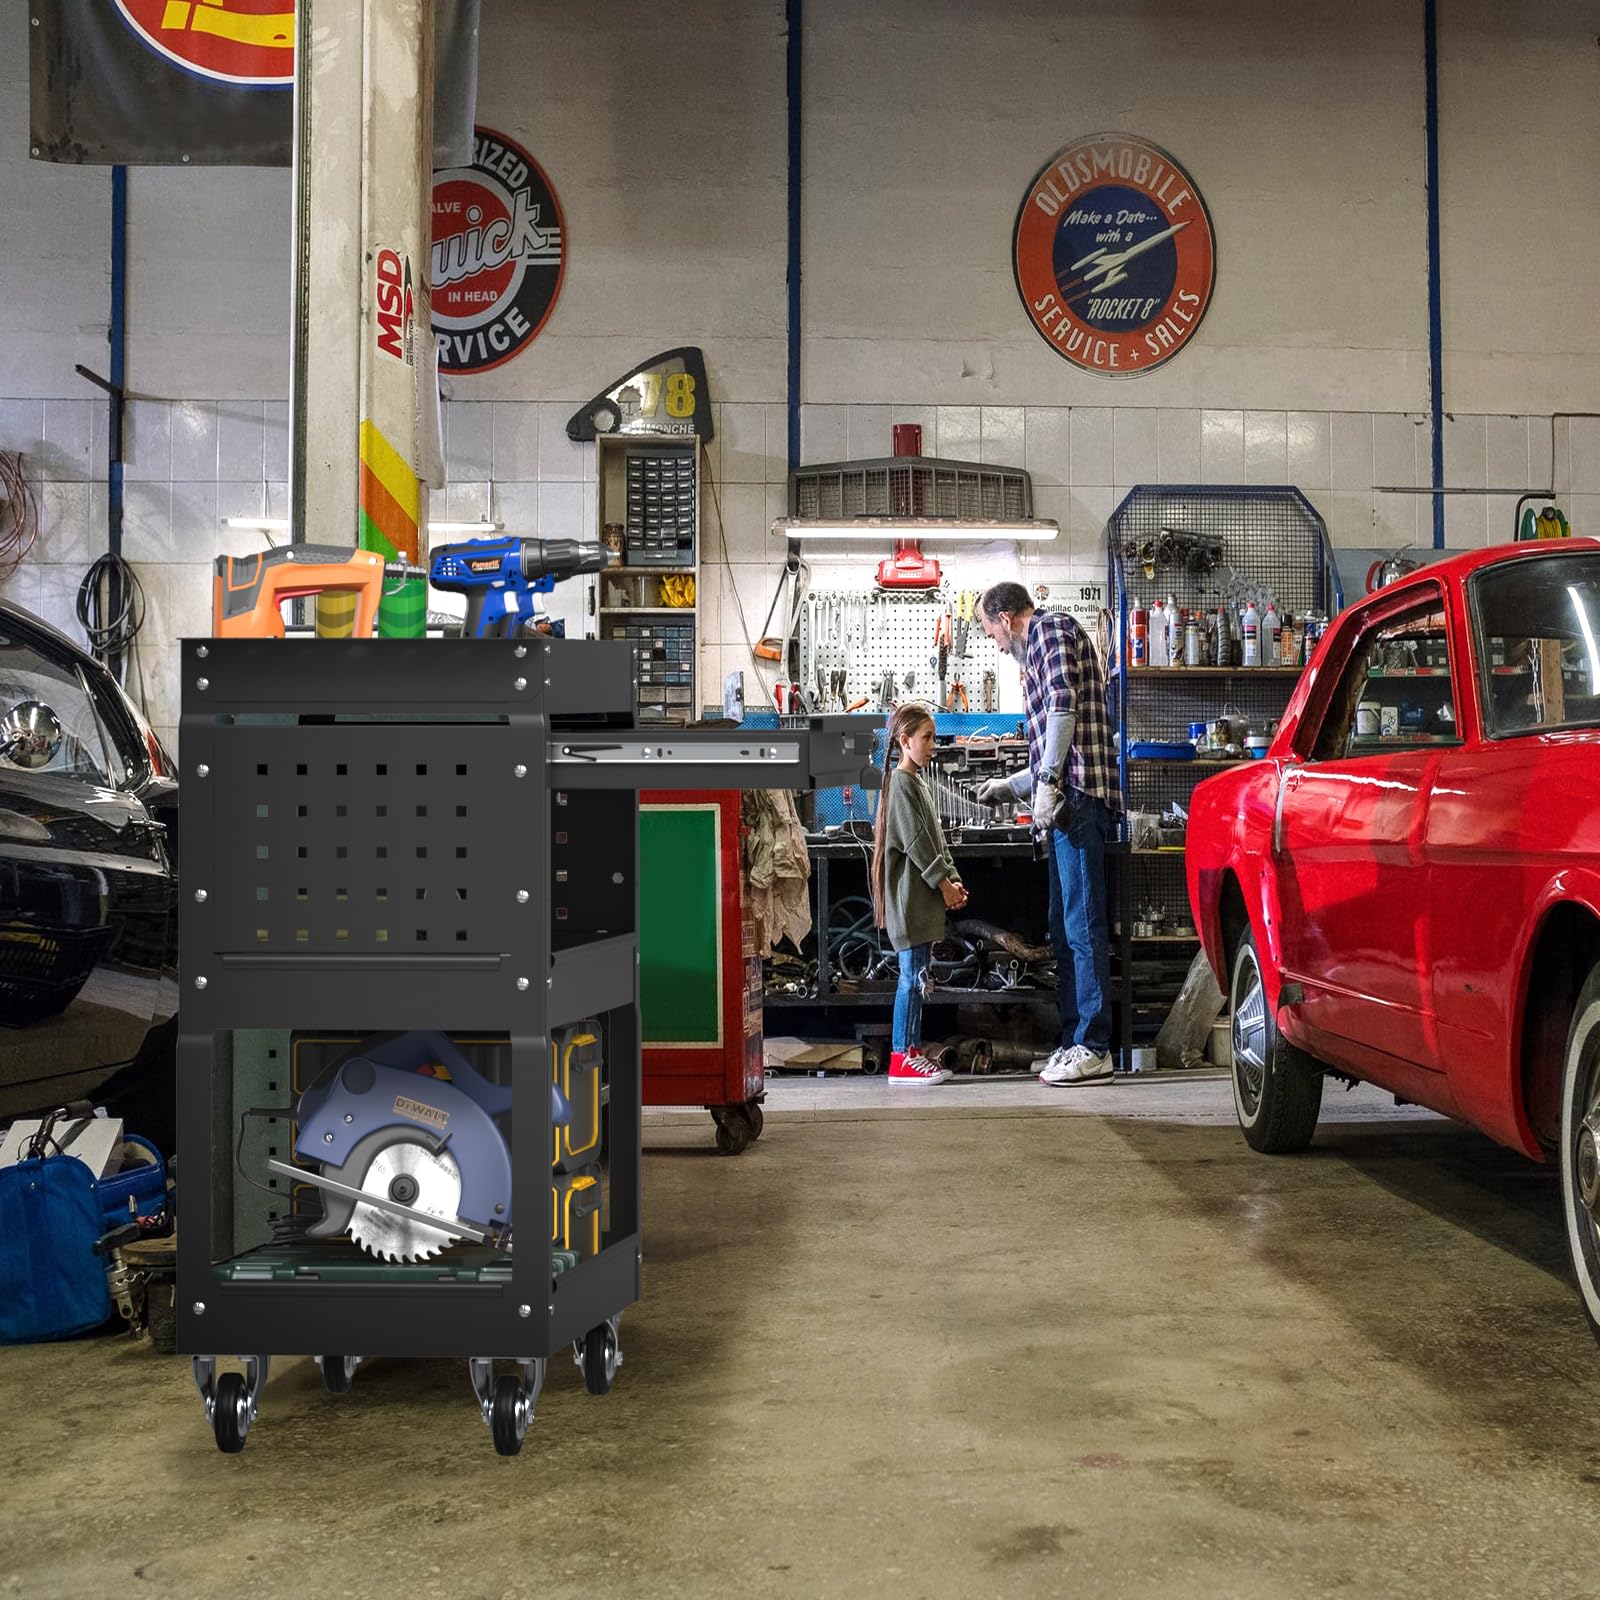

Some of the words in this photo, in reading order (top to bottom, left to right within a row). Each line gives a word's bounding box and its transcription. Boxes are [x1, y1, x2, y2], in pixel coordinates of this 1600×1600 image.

[1035, 148, 1192, 217] OLDSMOBILE
[432, 202, 461, 213] ALVE
[1064, 210, 1102, 227] Make
[1104, 213, 1112, 224] a
[432, 187, 547, 288] uick
[1096, 228, 1121, 242] with
[1125, 231, 1133, 242] a
[377, 249, 402, 359] MSD
[449, 292, 461, 303] IN
[465, 291, 498, 303] HEAD
[437, 306, 531, 364] RVICE
[1034, 293, 1120, 368] SERVICE
[1144, 289, 1200, 356] SALES
[1080, 587, 1101, 601] 1971
